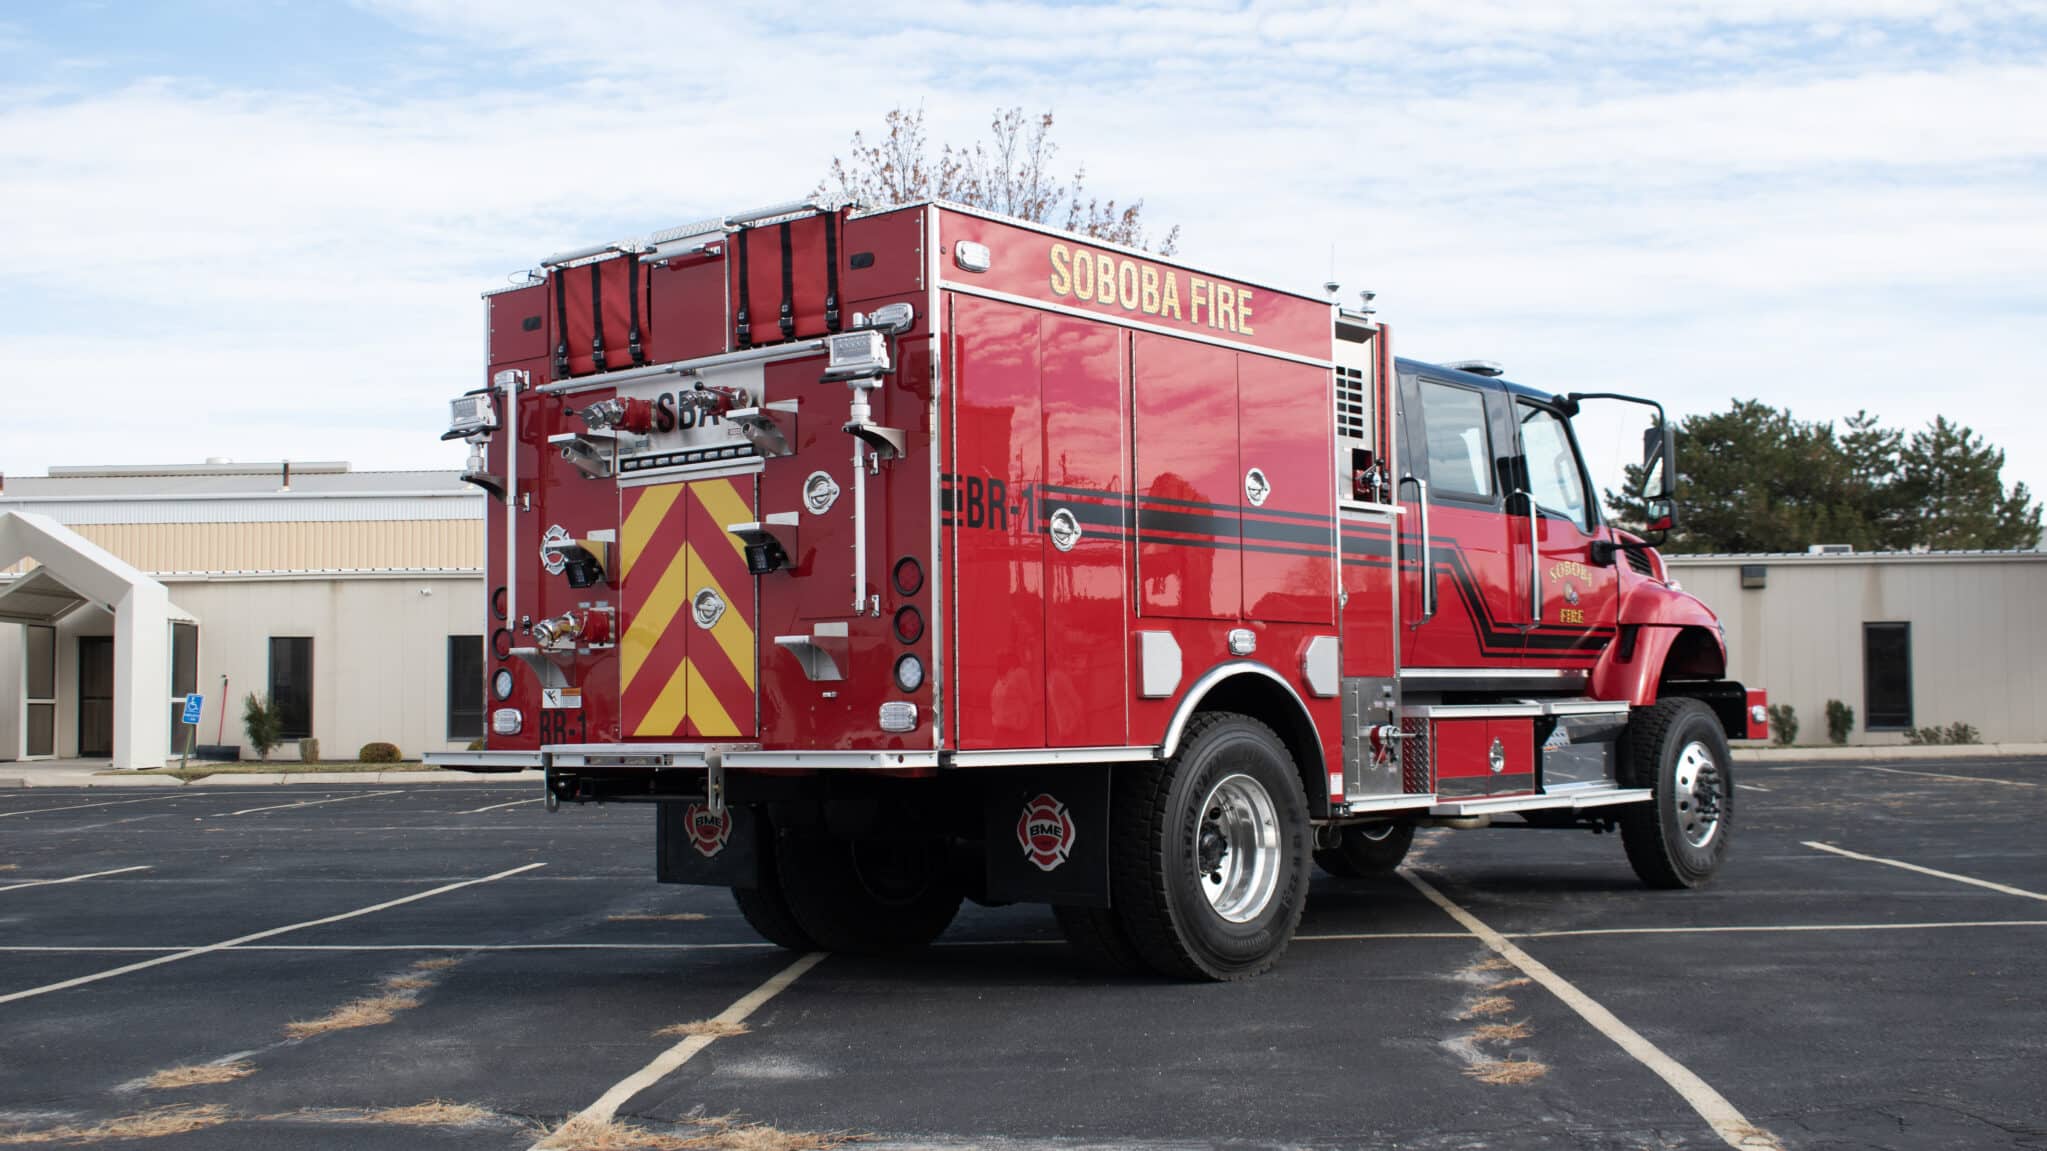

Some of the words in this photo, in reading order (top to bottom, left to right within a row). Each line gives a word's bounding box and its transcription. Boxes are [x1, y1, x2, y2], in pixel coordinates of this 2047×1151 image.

[1050, 243, 1182, 320] SOBOBA
[1189, 276, 1255, 336] FIRE
[967, 476, 1034, 533] BR-1
[1550, 561, 1592, 587] SOBOBA
[1560, 608, 1584, 624] FIRE
[1030, 823, 1063, 838] BME
